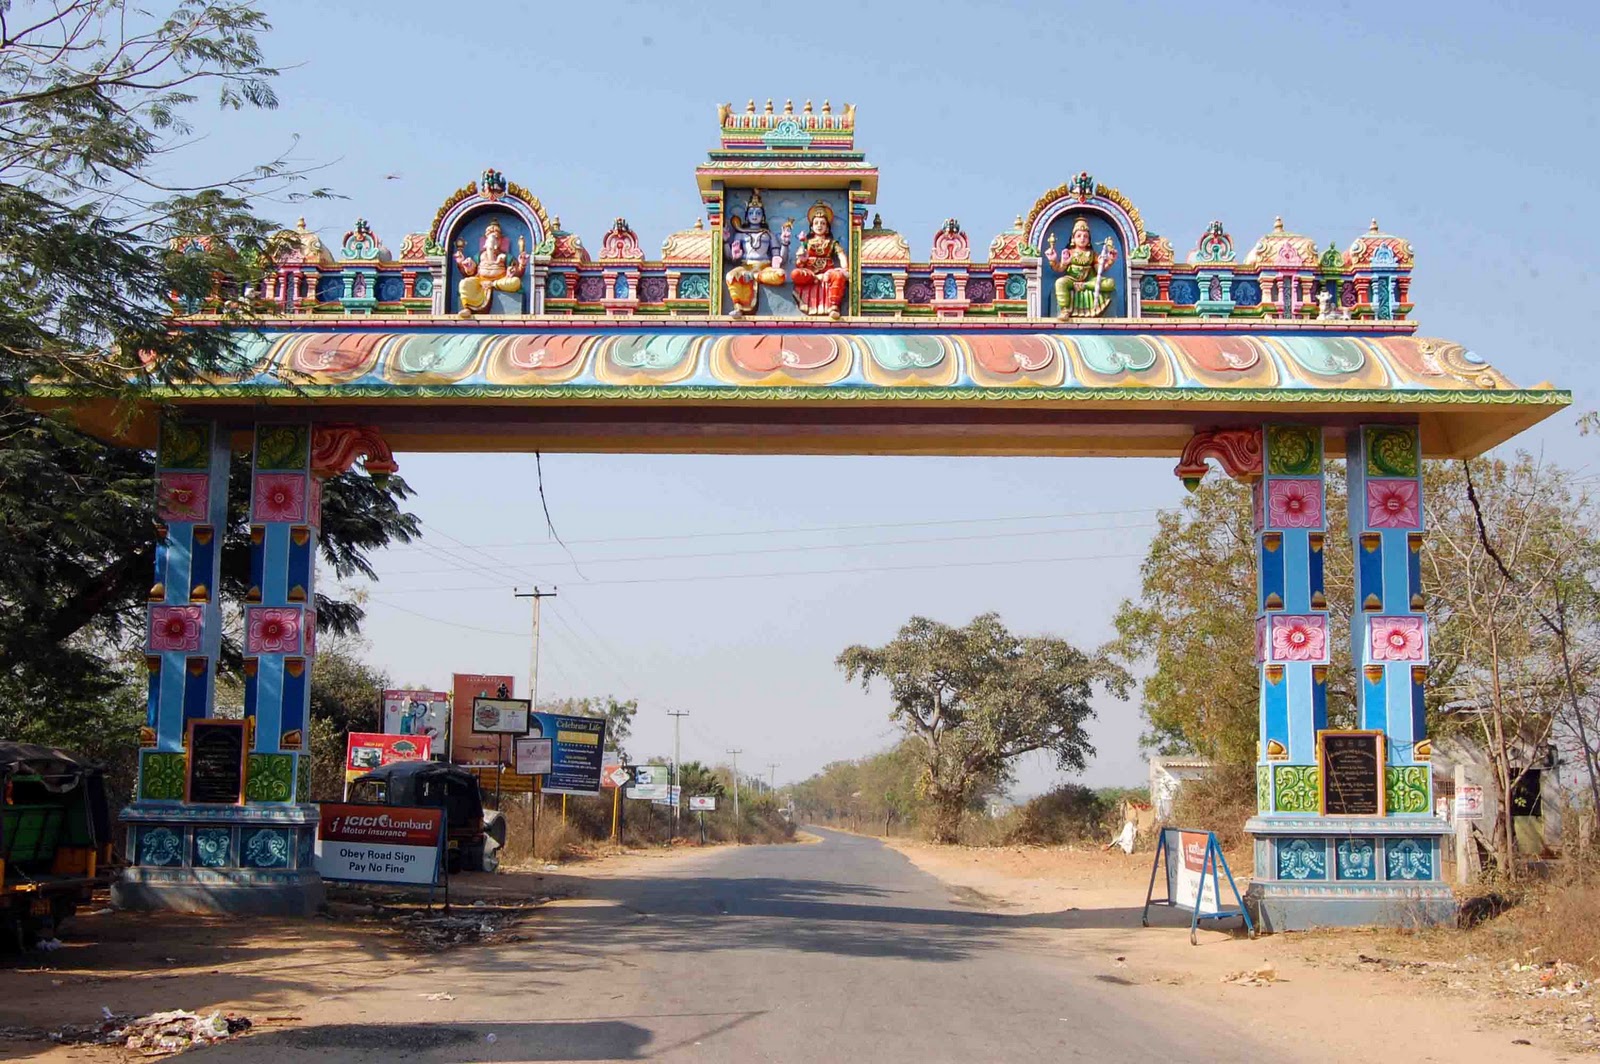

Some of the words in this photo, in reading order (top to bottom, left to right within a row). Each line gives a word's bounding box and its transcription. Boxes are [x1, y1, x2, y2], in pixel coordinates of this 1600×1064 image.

[556, 720, 588, 730] Celebrate
[588, 723, 601, 731] Life
[344, 816, 377, 827] ICICI
[388, 819, 433, 830] Lombard
[341, 826, 366, 834] Motor
[368, 827, 407, 837] Insurance
[340, 849, 365, 860] Obey
[367, 851, 392, 860] Road
[394, 852, 416, 863] Sign
[349, 862, 366, 873] Pay
[368, 863, 382, 872] No
[385, 864, 405, 873] Fine
